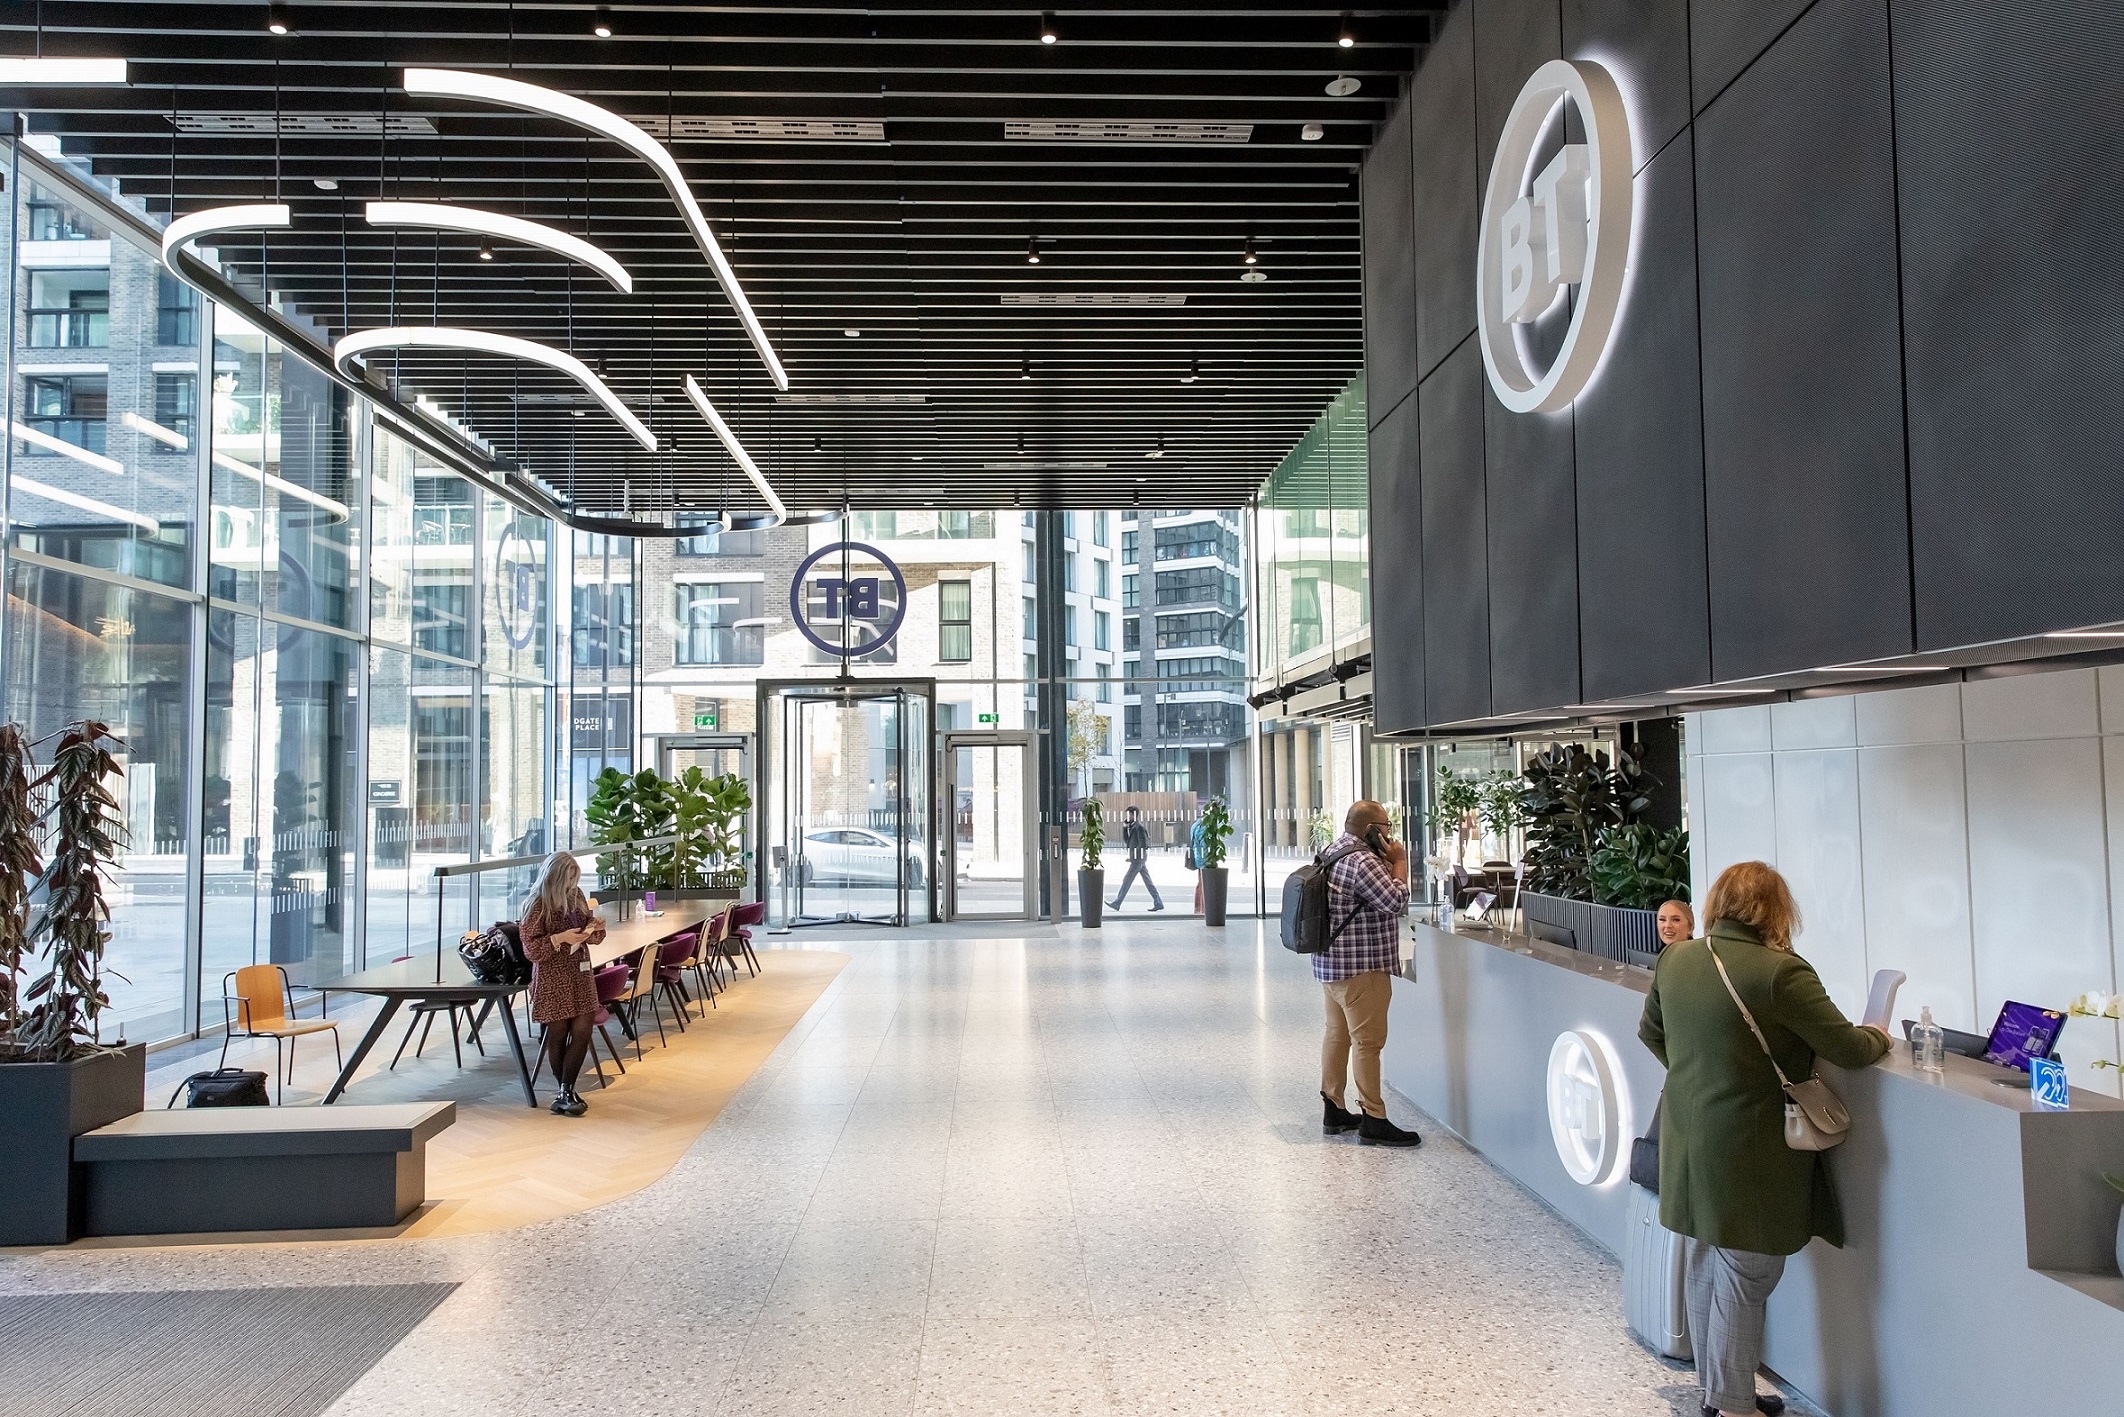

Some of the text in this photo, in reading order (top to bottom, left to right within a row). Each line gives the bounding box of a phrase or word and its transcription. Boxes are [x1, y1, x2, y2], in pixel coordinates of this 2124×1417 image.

[1501, 144, 1568, 323] BT
[573, 717, 600, 725] DGATE
[1560, 1073, 1594, 1139] BT
